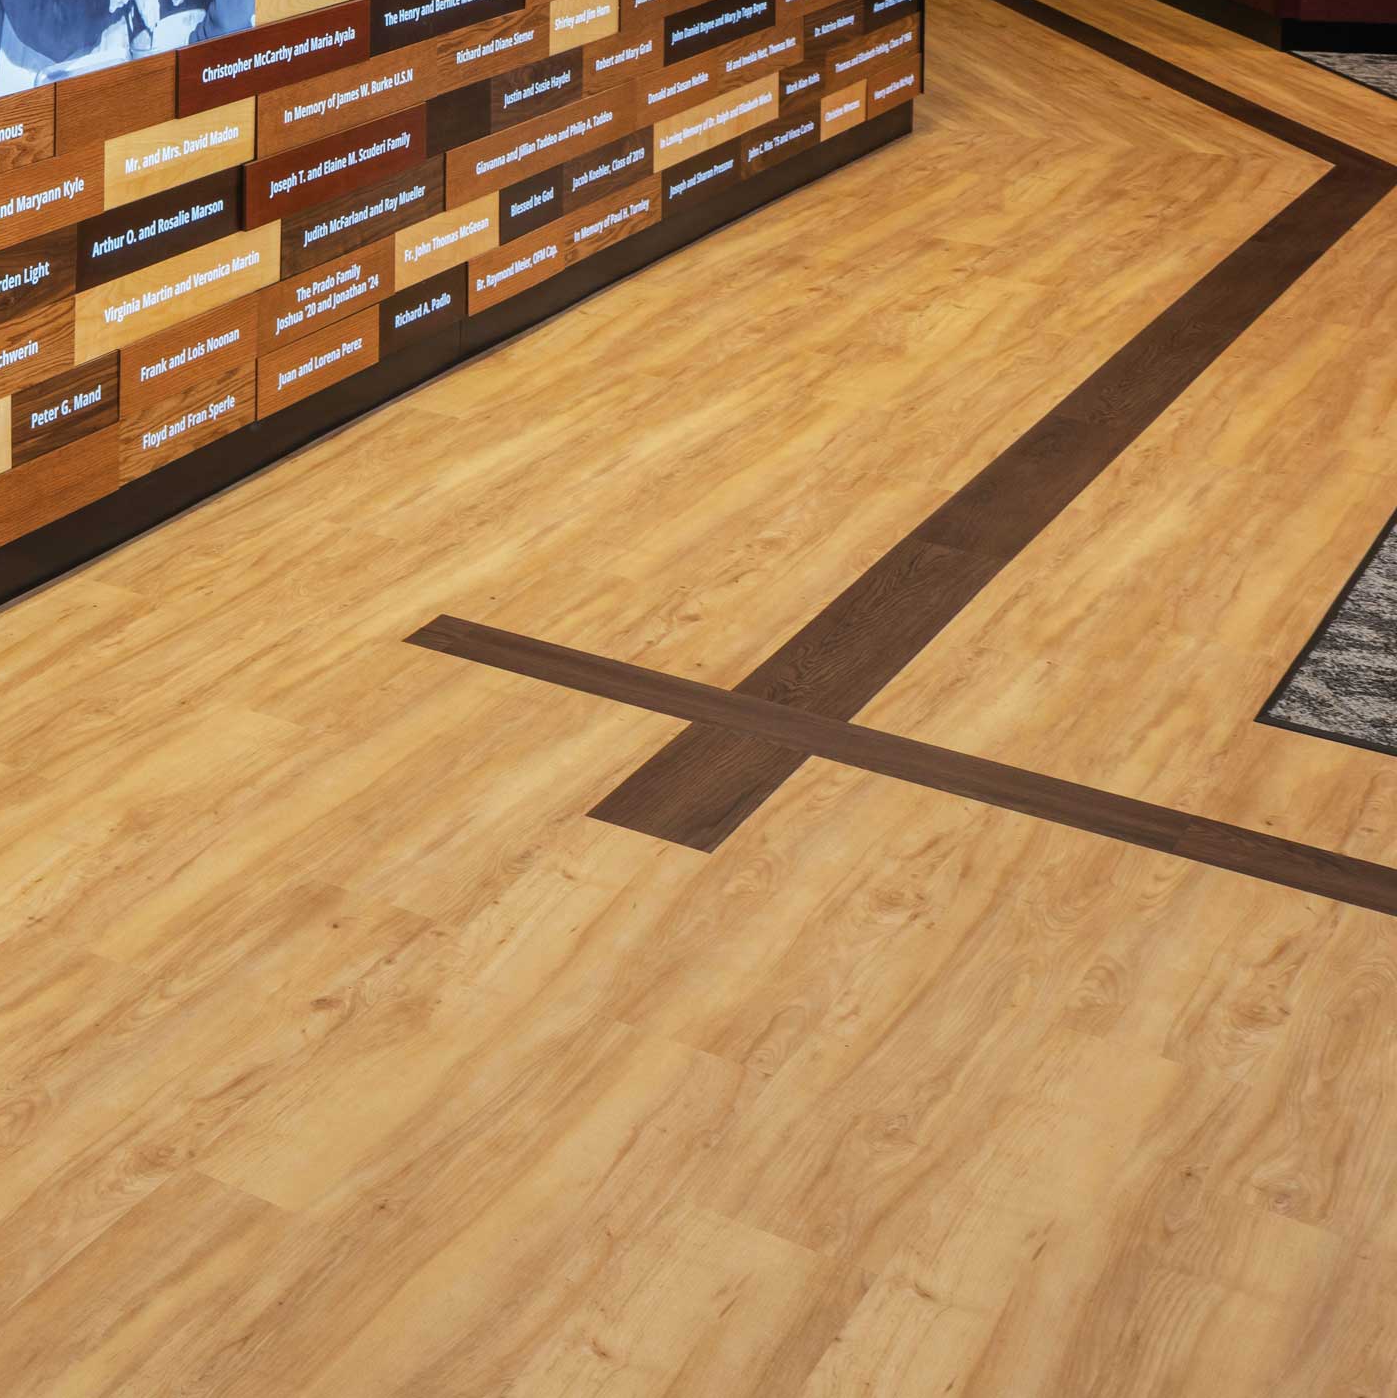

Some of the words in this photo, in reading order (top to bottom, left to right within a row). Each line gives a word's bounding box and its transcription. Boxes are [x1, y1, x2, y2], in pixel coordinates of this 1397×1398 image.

[31, 406, 59, 429] Peter
[60, 399, 71, 415] G.
[73, 384, 101, 411] Mand
